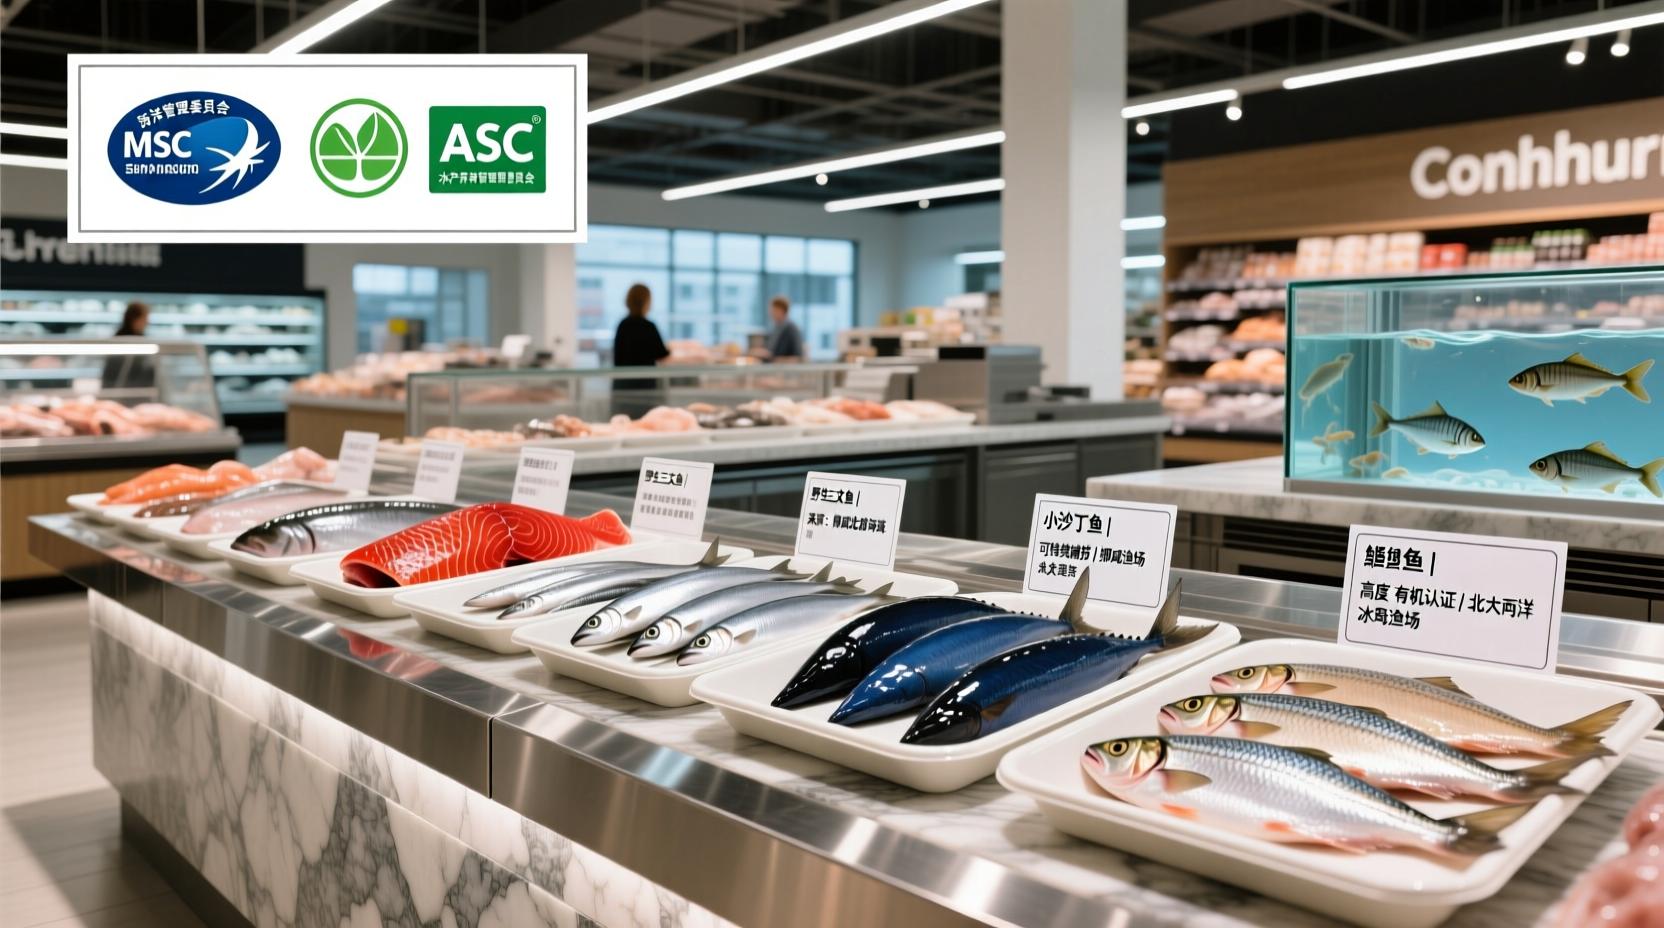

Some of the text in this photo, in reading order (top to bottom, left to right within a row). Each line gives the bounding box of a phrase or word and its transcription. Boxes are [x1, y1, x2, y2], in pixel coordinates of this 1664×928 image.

[1410, 129, 1664, 199] Conhhur
[1043, 511, 1102, 533] 小沙丁鱼
[1394, 585, 1457, 609] 有机认证
